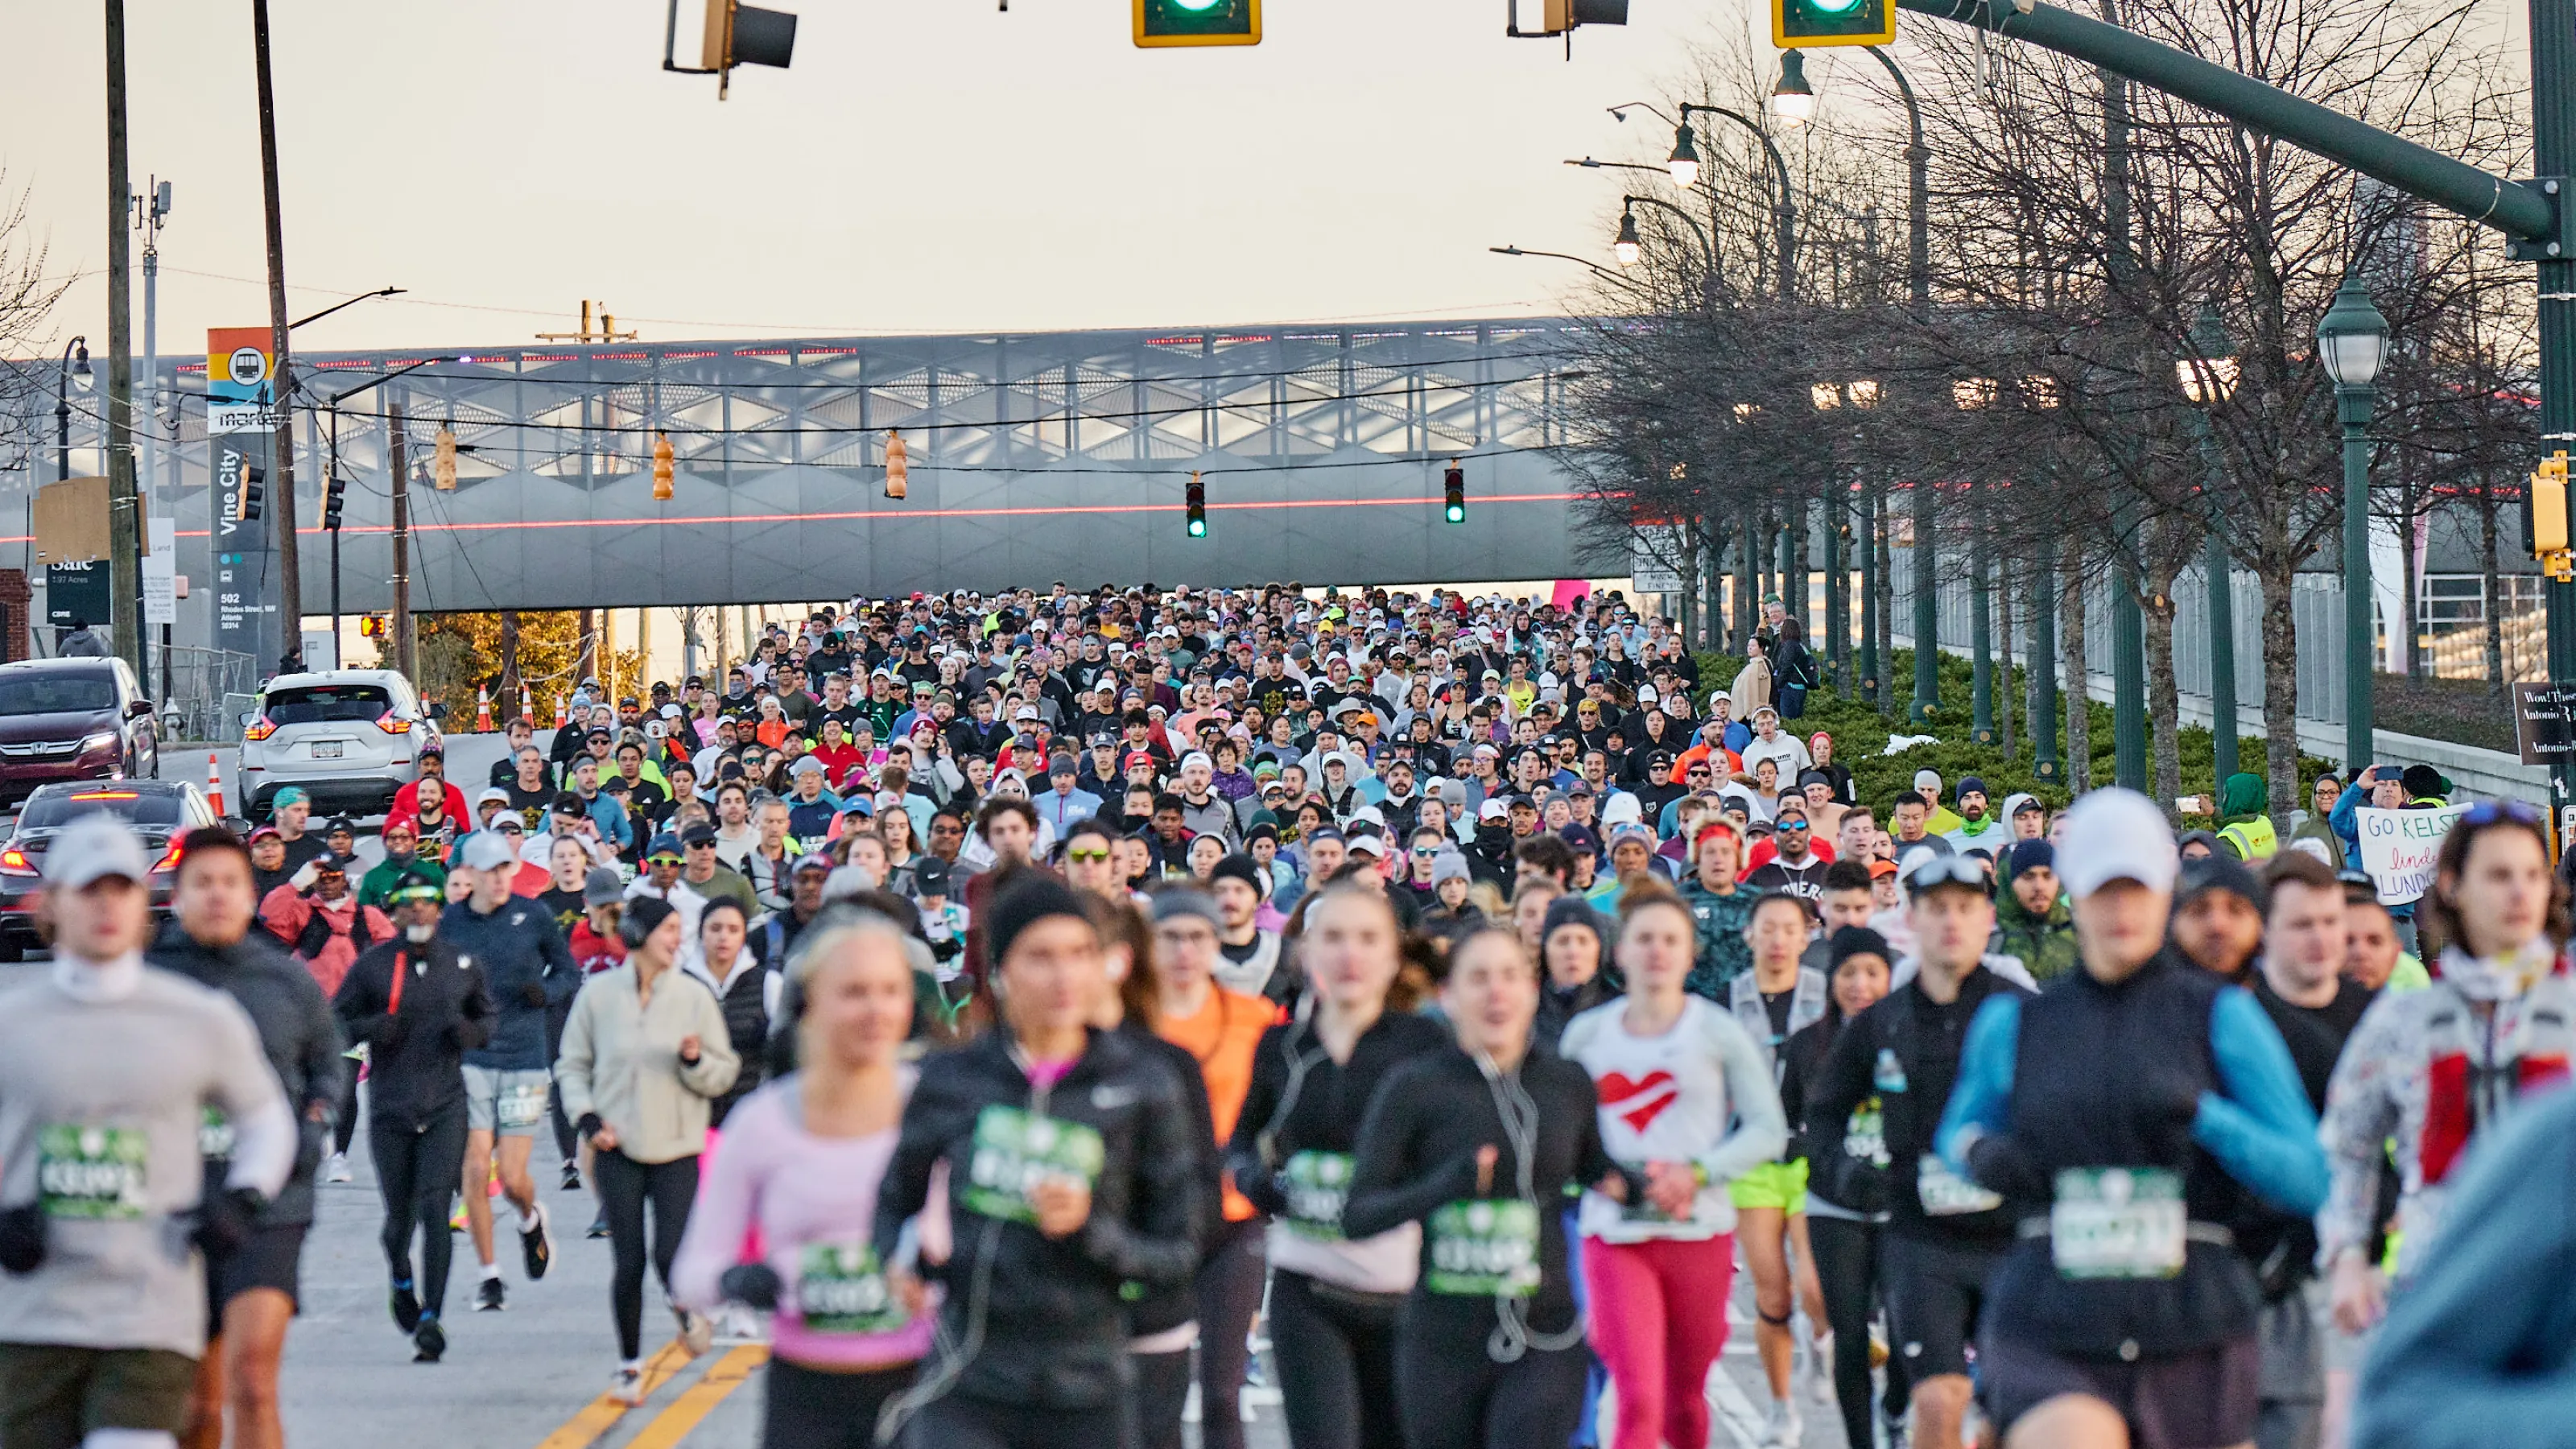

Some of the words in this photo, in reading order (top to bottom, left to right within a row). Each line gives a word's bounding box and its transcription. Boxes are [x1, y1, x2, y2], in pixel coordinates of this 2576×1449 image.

[219, 448, 240, 487] City
[219, 492, 239, 536] Vine
[221, 593, 240, 604] 502
[2524, 691, 2551, 703] Wow!
[2523, 708, 2560, 720] Antonio
[2368, 815, 2394, 837] GO
